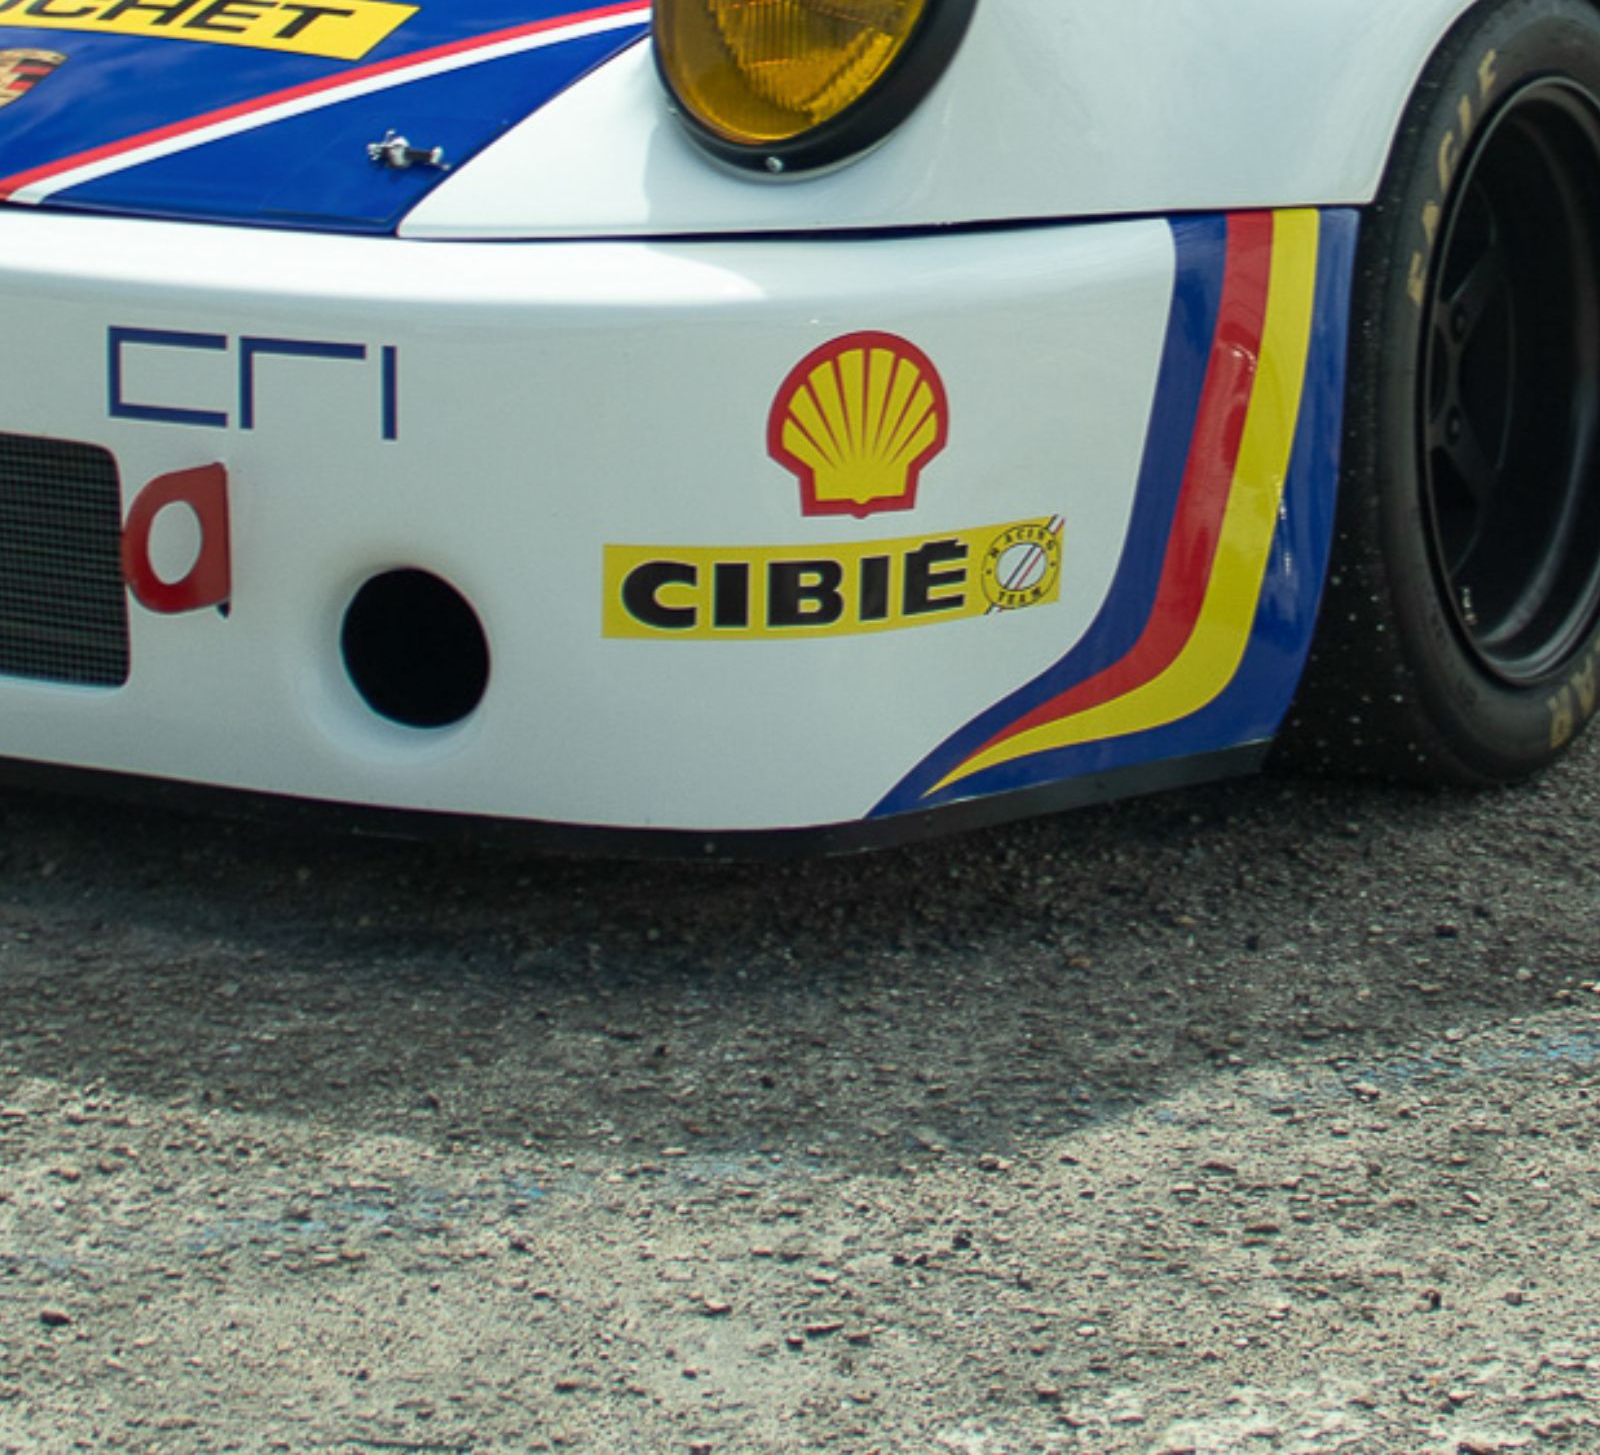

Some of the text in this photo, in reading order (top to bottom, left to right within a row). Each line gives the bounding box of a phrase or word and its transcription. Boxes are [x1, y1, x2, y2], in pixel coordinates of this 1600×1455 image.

[1406, 48, 1498, 309] EAGLE
[990, 526, 1057, 558] RACING
[620, 537, 969, 630] CIBIÉ
[997, 587, 1042, 608] TEAM
